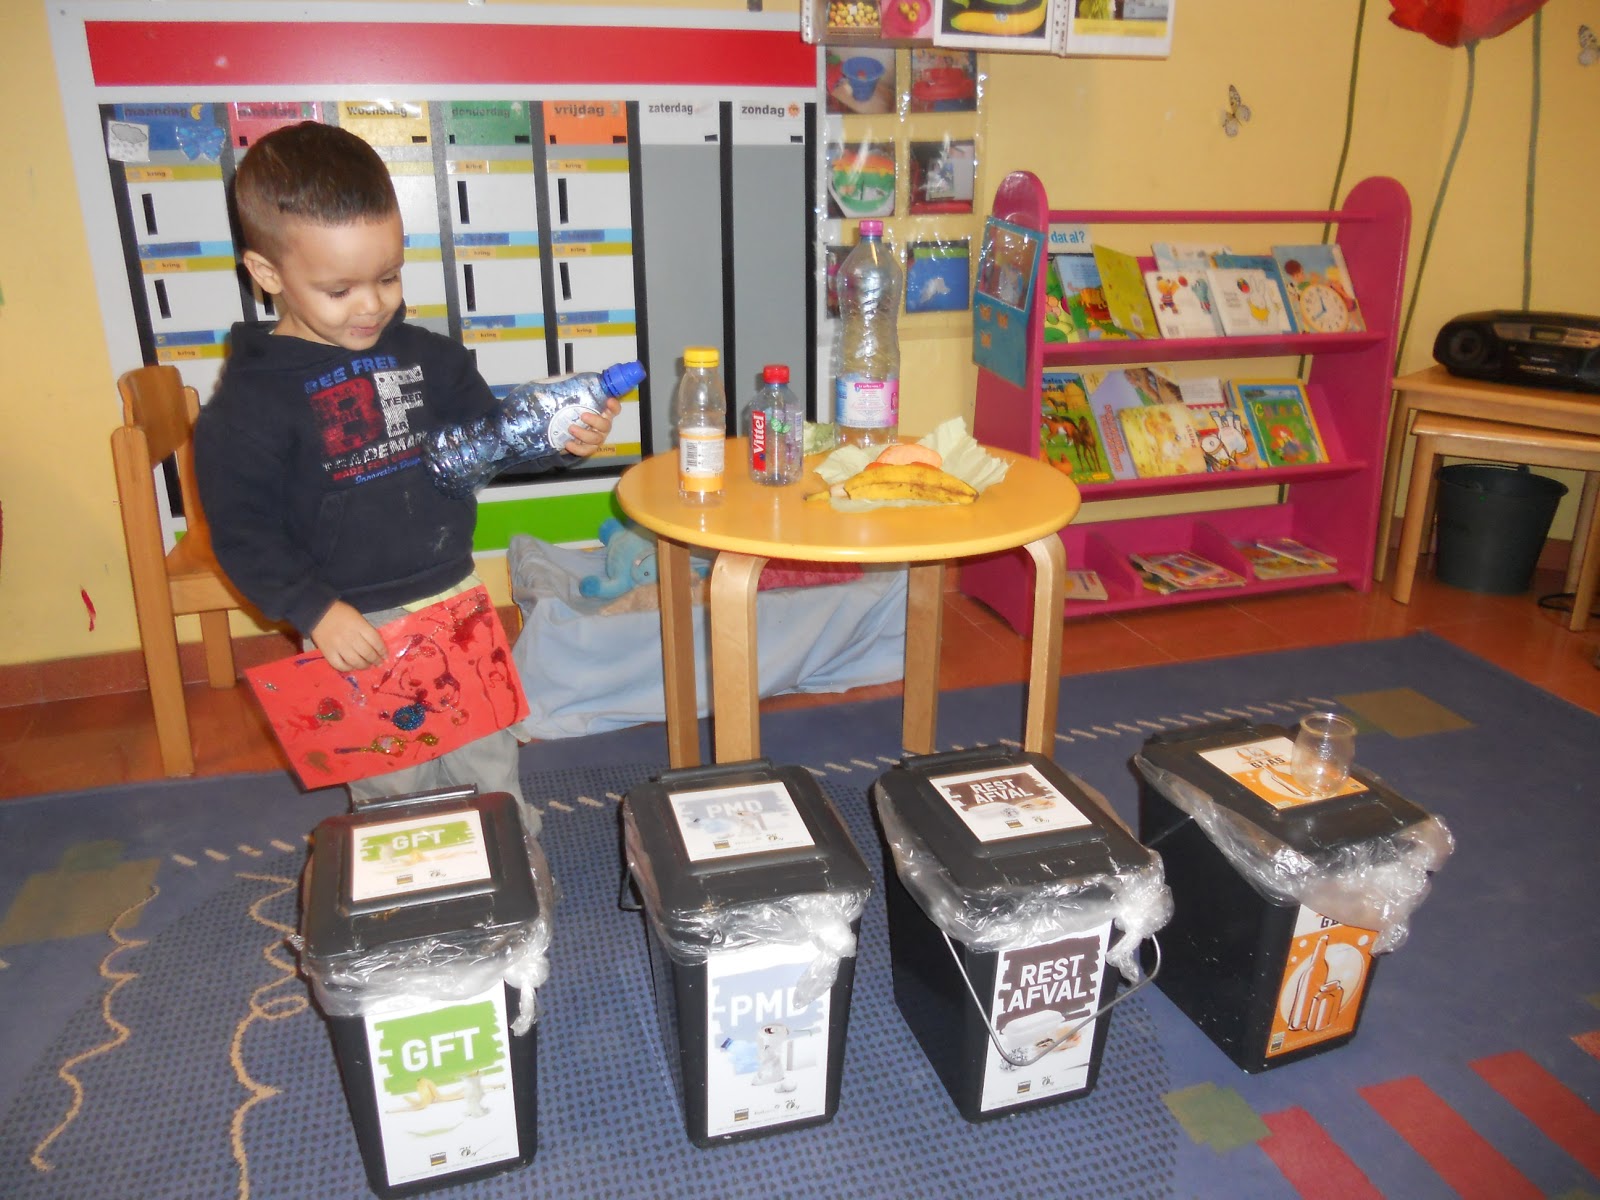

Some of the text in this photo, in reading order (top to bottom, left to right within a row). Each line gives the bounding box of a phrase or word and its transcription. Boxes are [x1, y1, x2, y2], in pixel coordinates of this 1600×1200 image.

[452, 105, 510, 118] donderdag
[554, 104, 605, 117] vrijdag
[648, 102, 693, 115] zaterdag
[741, 105, 785, 117] zondag
[1070, 231, 1085, 243] al?
[753, 414, 765, 454] Vittel
[974, 778, 1018, 796] REST
[974, 787, 1034, 805] AFVAL
[706, 801, 764, 818] PMD
[391, 828, 446, 852] GFT
[1020, 955, 1085, 988] REST
[1007, 977, 1087, 1015] AFVAL
[401, 1027, 481, 1073] GFT
